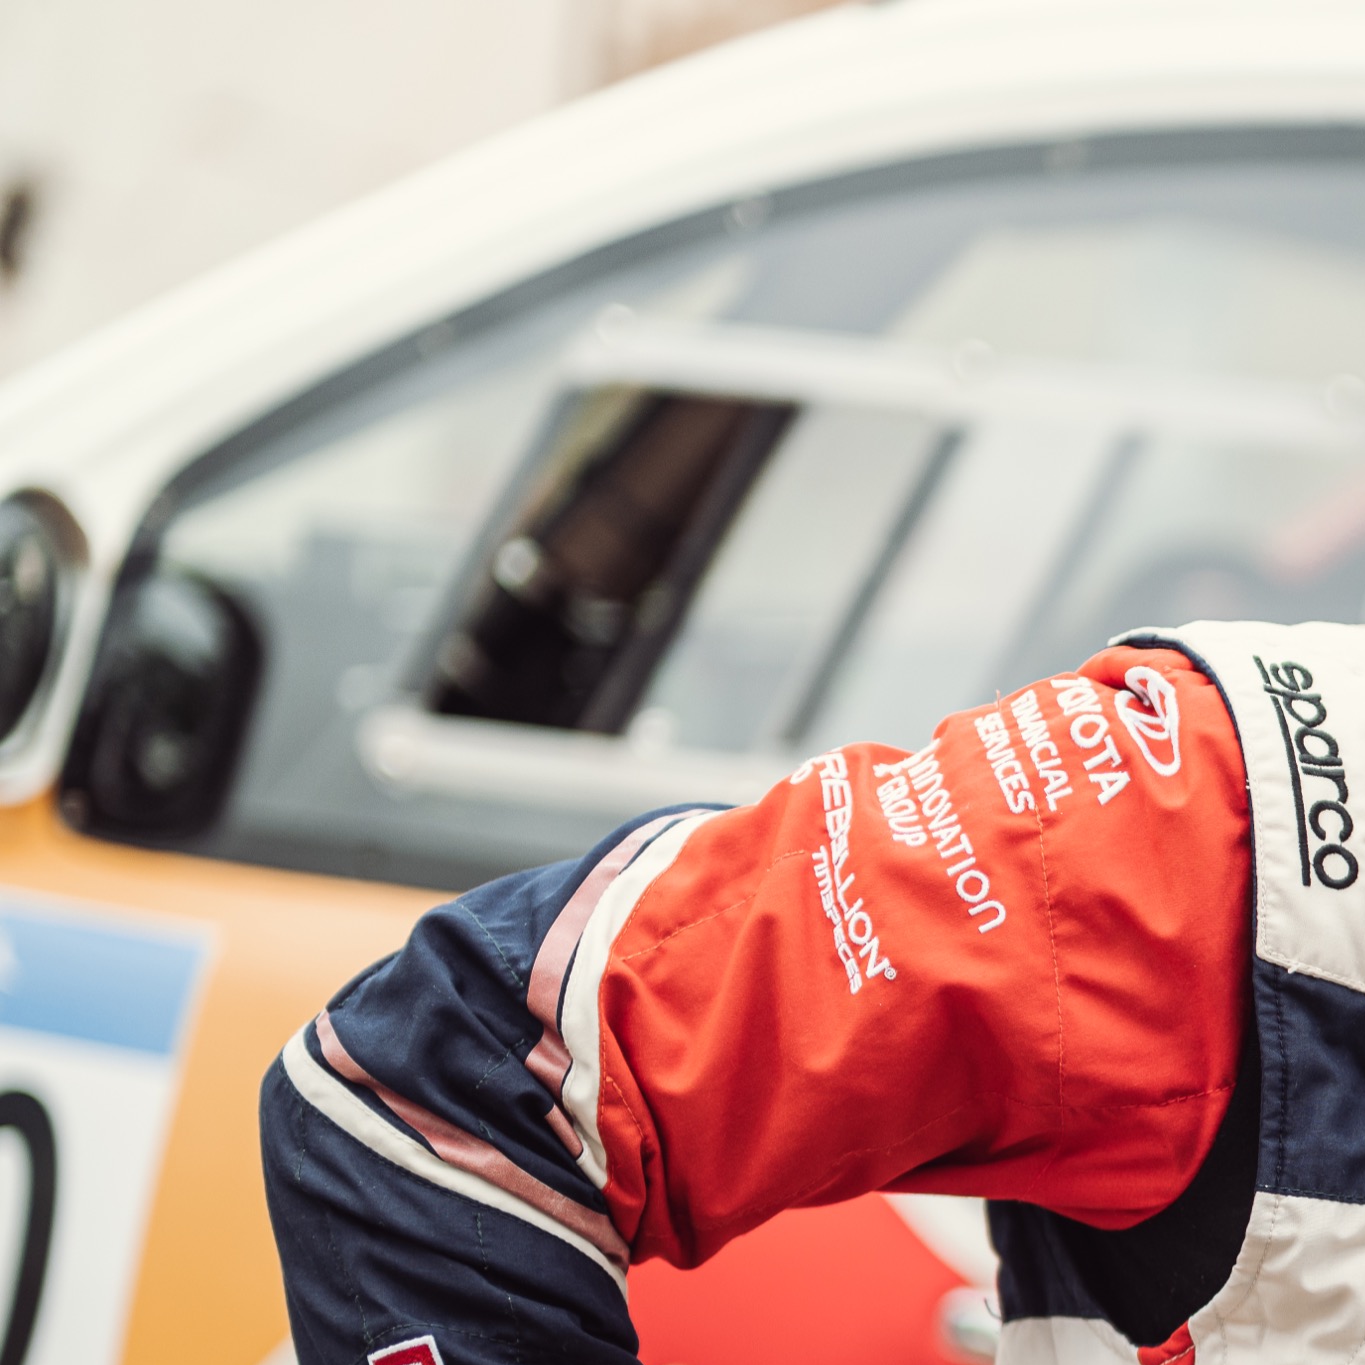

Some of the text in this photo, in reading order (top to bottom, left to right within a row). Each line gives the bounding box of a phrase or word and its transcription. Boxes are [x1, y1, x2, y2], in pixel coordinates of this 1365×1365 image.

[974, 711, 1036, 814] SERVICES
[1010, 689, 1073, 812] FINANCIAL
[1051, 676, 1131, 805] TOYOTA
[1262, 660, 1360, 891] sparco
[876, 774, 927, 846] GROUP
